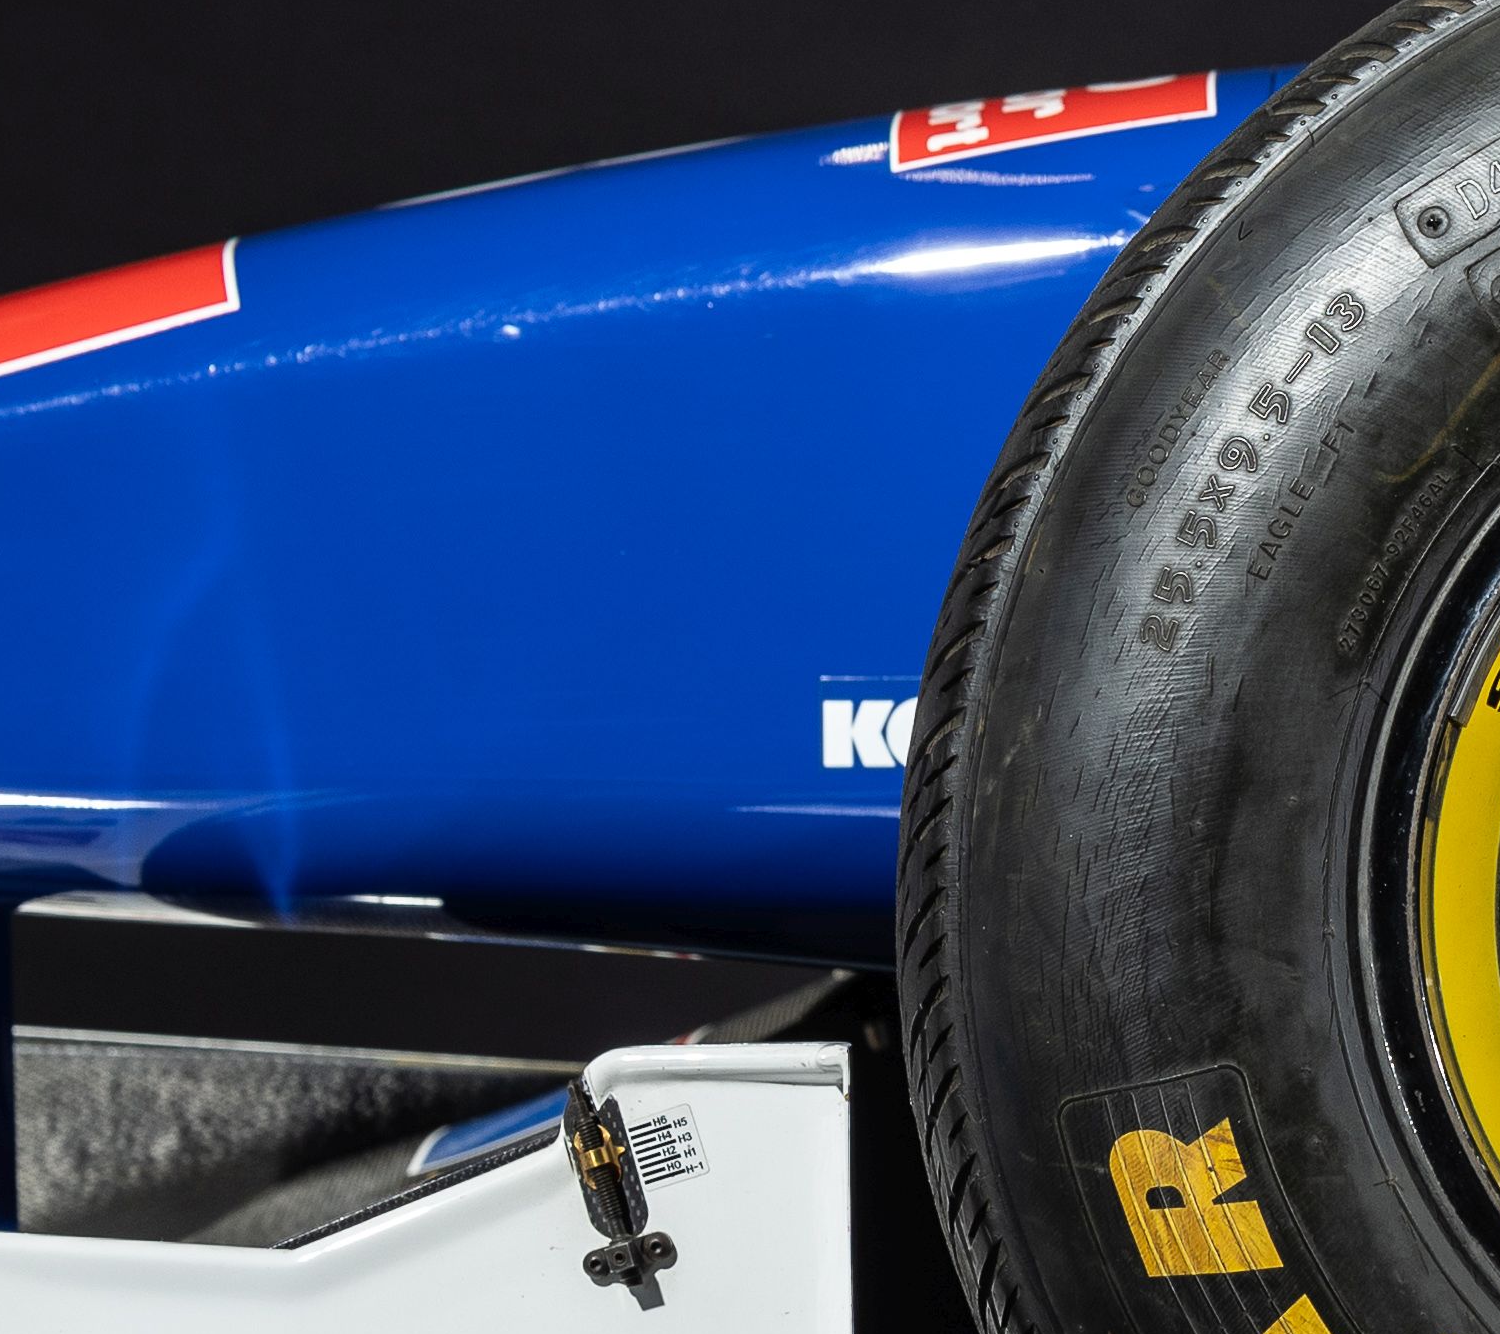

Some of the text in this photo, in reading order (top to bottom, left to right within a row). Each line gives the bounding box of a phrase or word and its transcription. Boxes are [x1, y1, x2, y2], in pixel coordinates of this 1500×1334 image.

[1126, 348, 1232, 508] GOODYEAR
[1248, 476, 1315, 582] EAGLE
[652, 1114, 668, 1127] H6
[672, 1116, 688, 1129] H5
[657, 1130, 672, 1142] H4
[677, 1131, 693, 1143] H3
[662, 1145, 677, 1157] H2
[683, 1147, 697, 1158] H1
